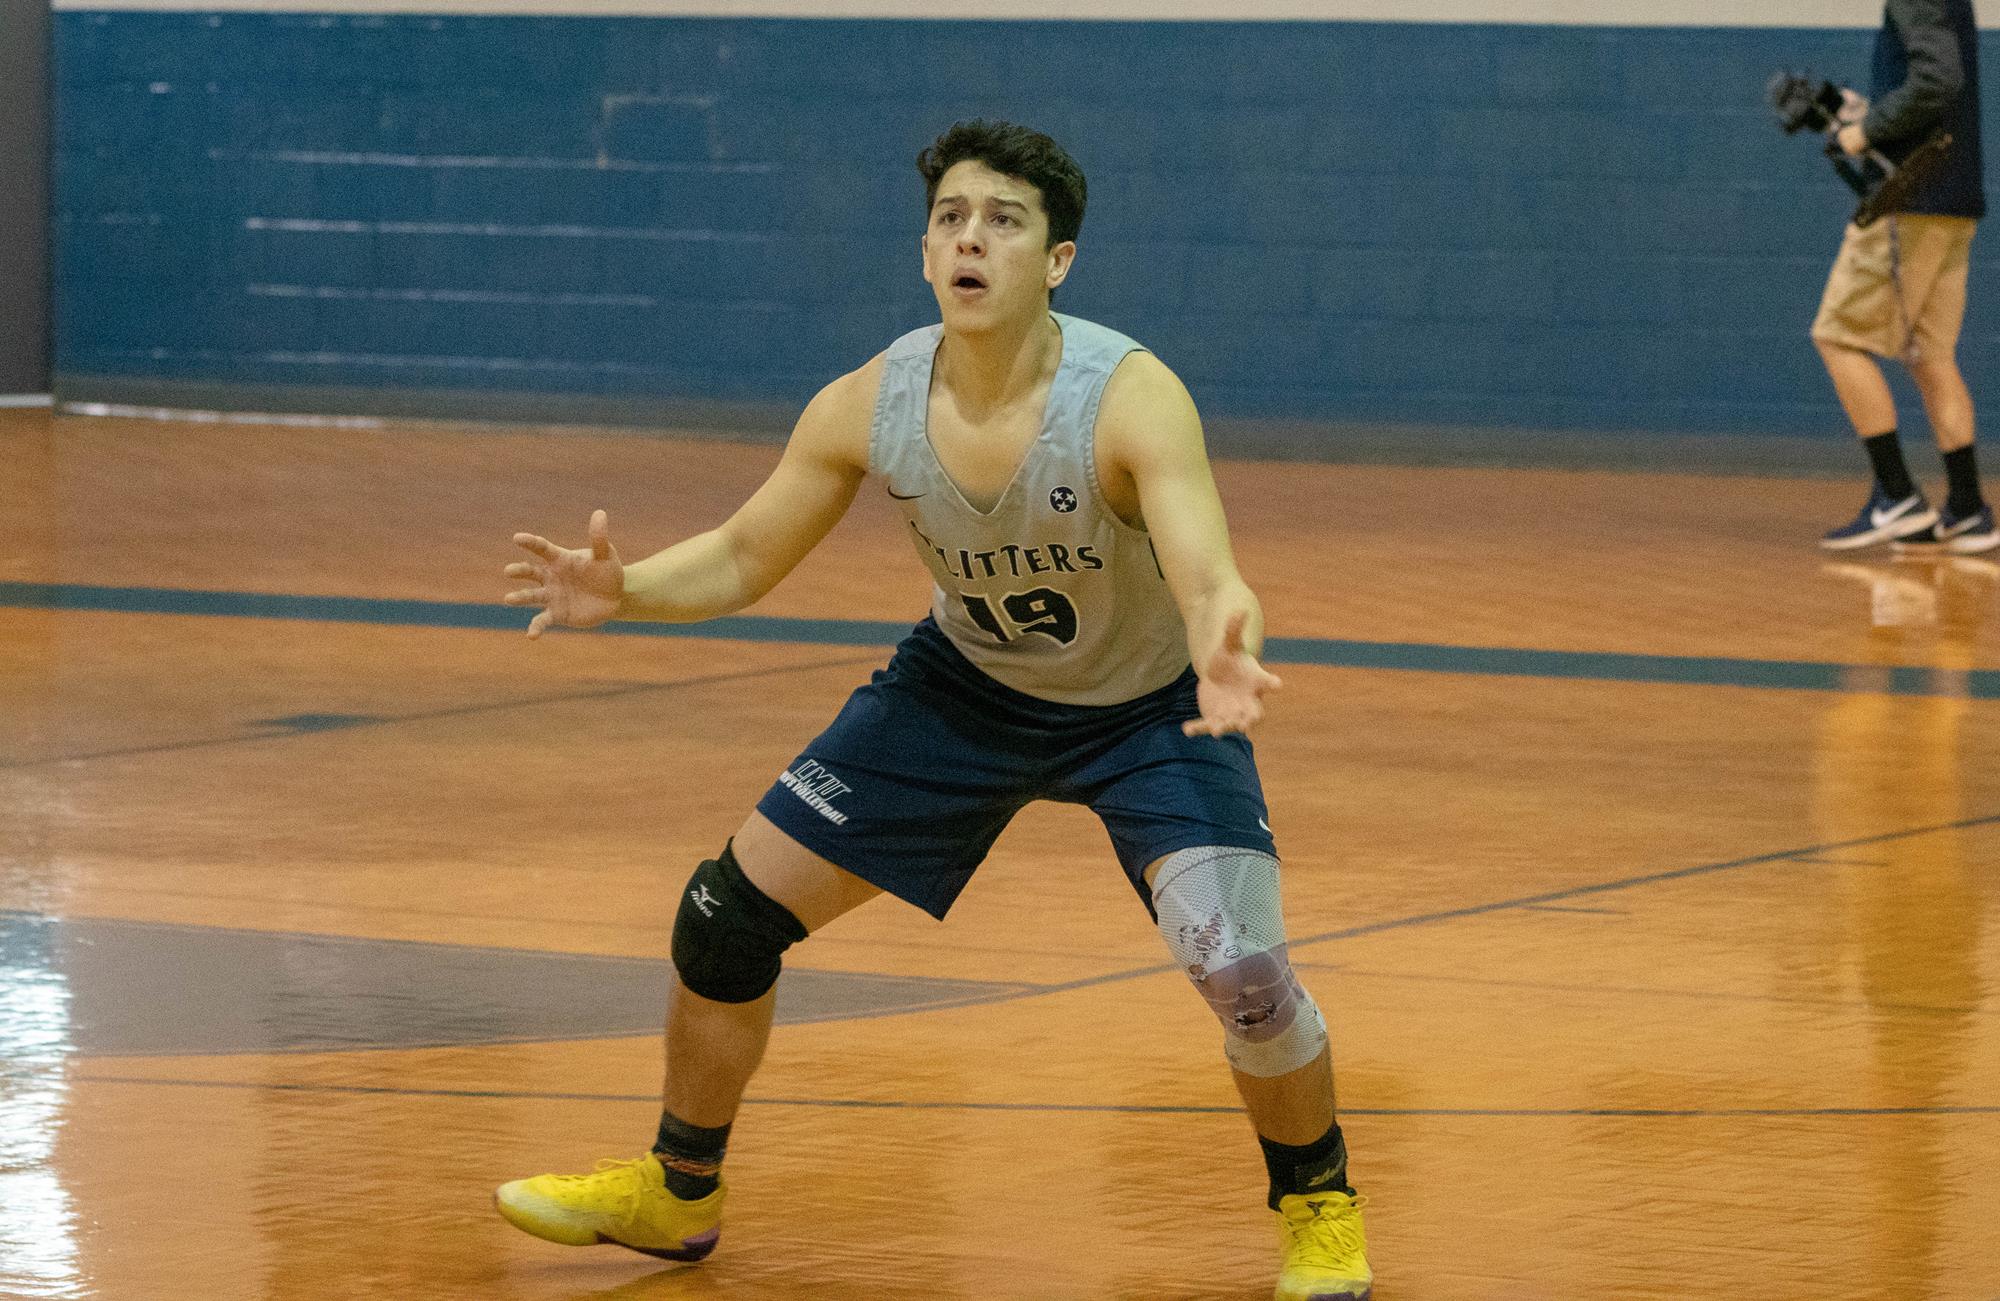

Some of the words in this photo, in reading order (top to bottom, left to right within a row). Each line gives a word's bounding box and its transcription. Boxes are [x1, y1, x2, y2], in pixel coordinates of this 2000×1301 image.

[935, 542, 1104, 581] LITTERS
[959, 586, 1081, 649] 19
[792, 759, 852, 801] LMU
[790, 781, 849, 826] VOLLEYBALL
